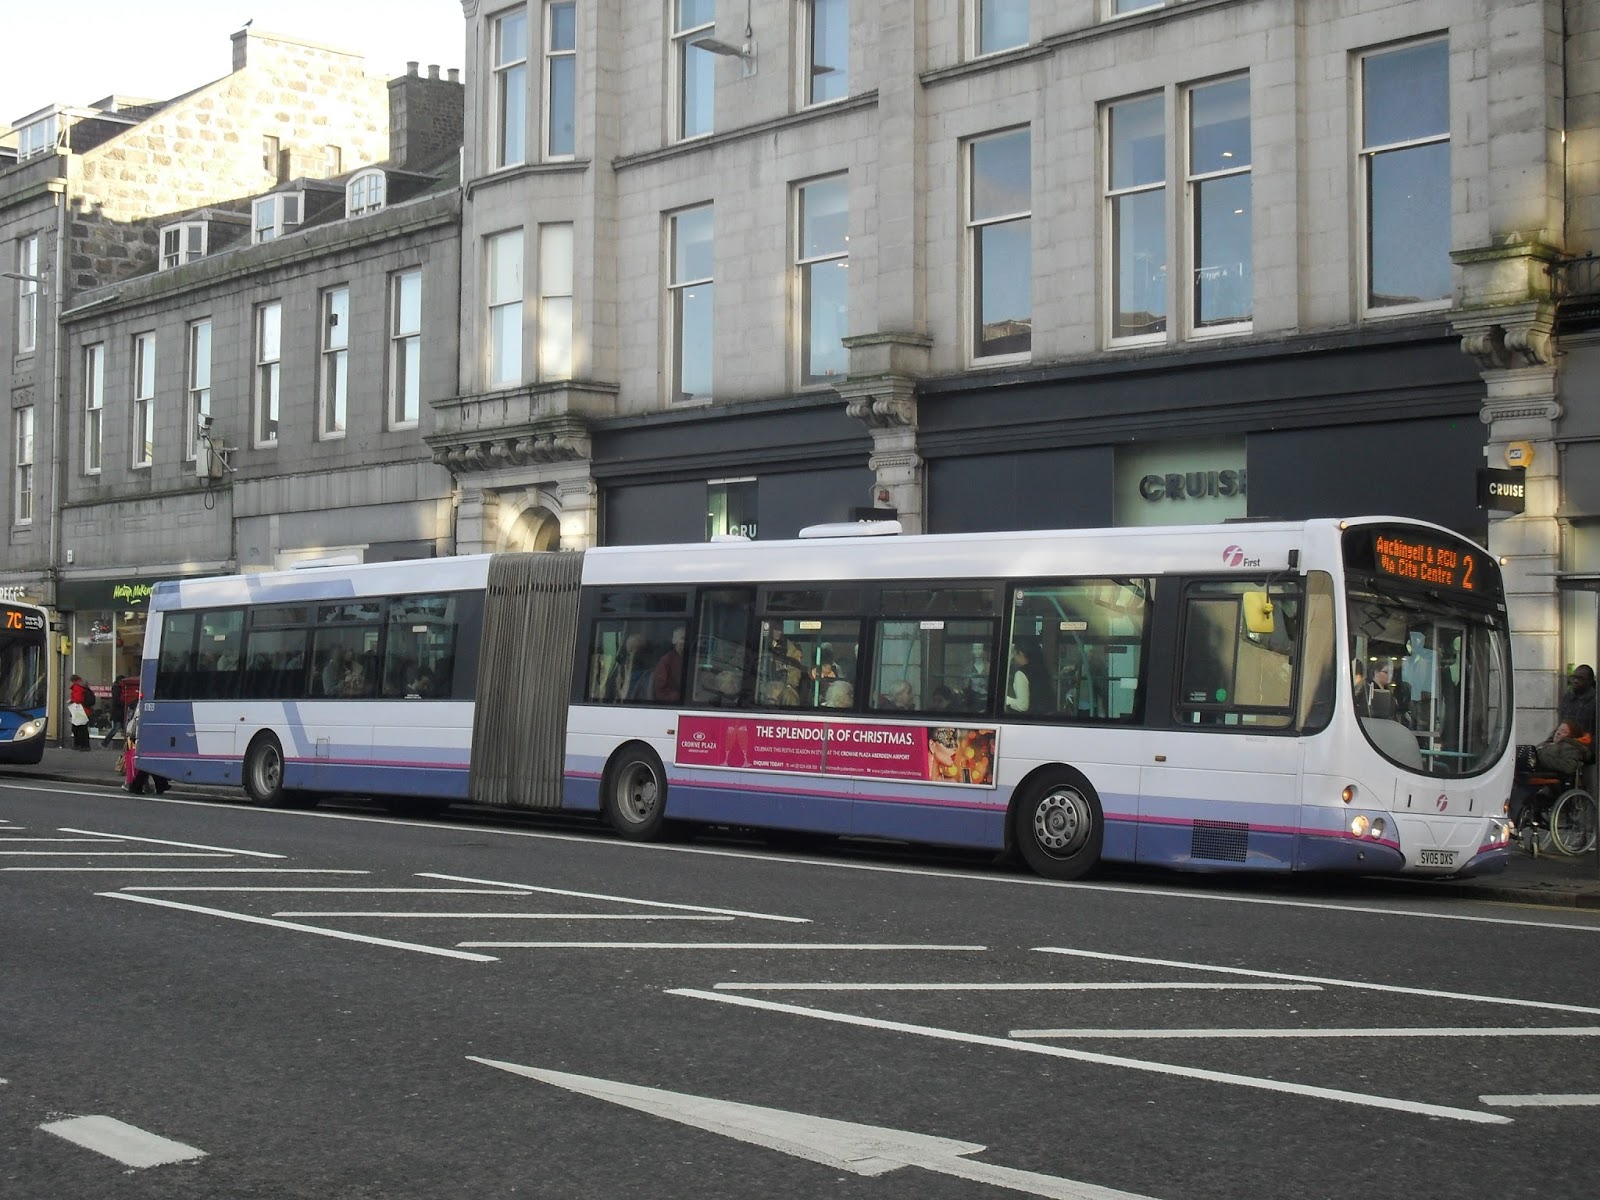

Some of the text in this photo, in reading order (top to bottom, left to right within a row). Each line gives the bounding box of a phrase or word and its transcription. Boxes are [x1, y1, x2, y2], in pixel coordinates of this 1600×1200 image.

[1489, 482, 1524, 497] CRUISE
[1243, 558, 1260, 567] First
[1426, 546, 1434, 564] &
[1437, 548, 1457, 569] RGU
[1398, 559, 1418, 578] City
[1421, 563, 1452, 584] Centre
[1462, 554, 1474, 591] 2
[6, 611, 23, 629] 7C
[756, 725, 915, 745] THE SPLENDOUR OF CHRISTMAS.
[681, 740, 700, 749] CROWNE
[871, 752, 892, 760] ABERDEEN
[1440, 853, 1454, 865] DXS
